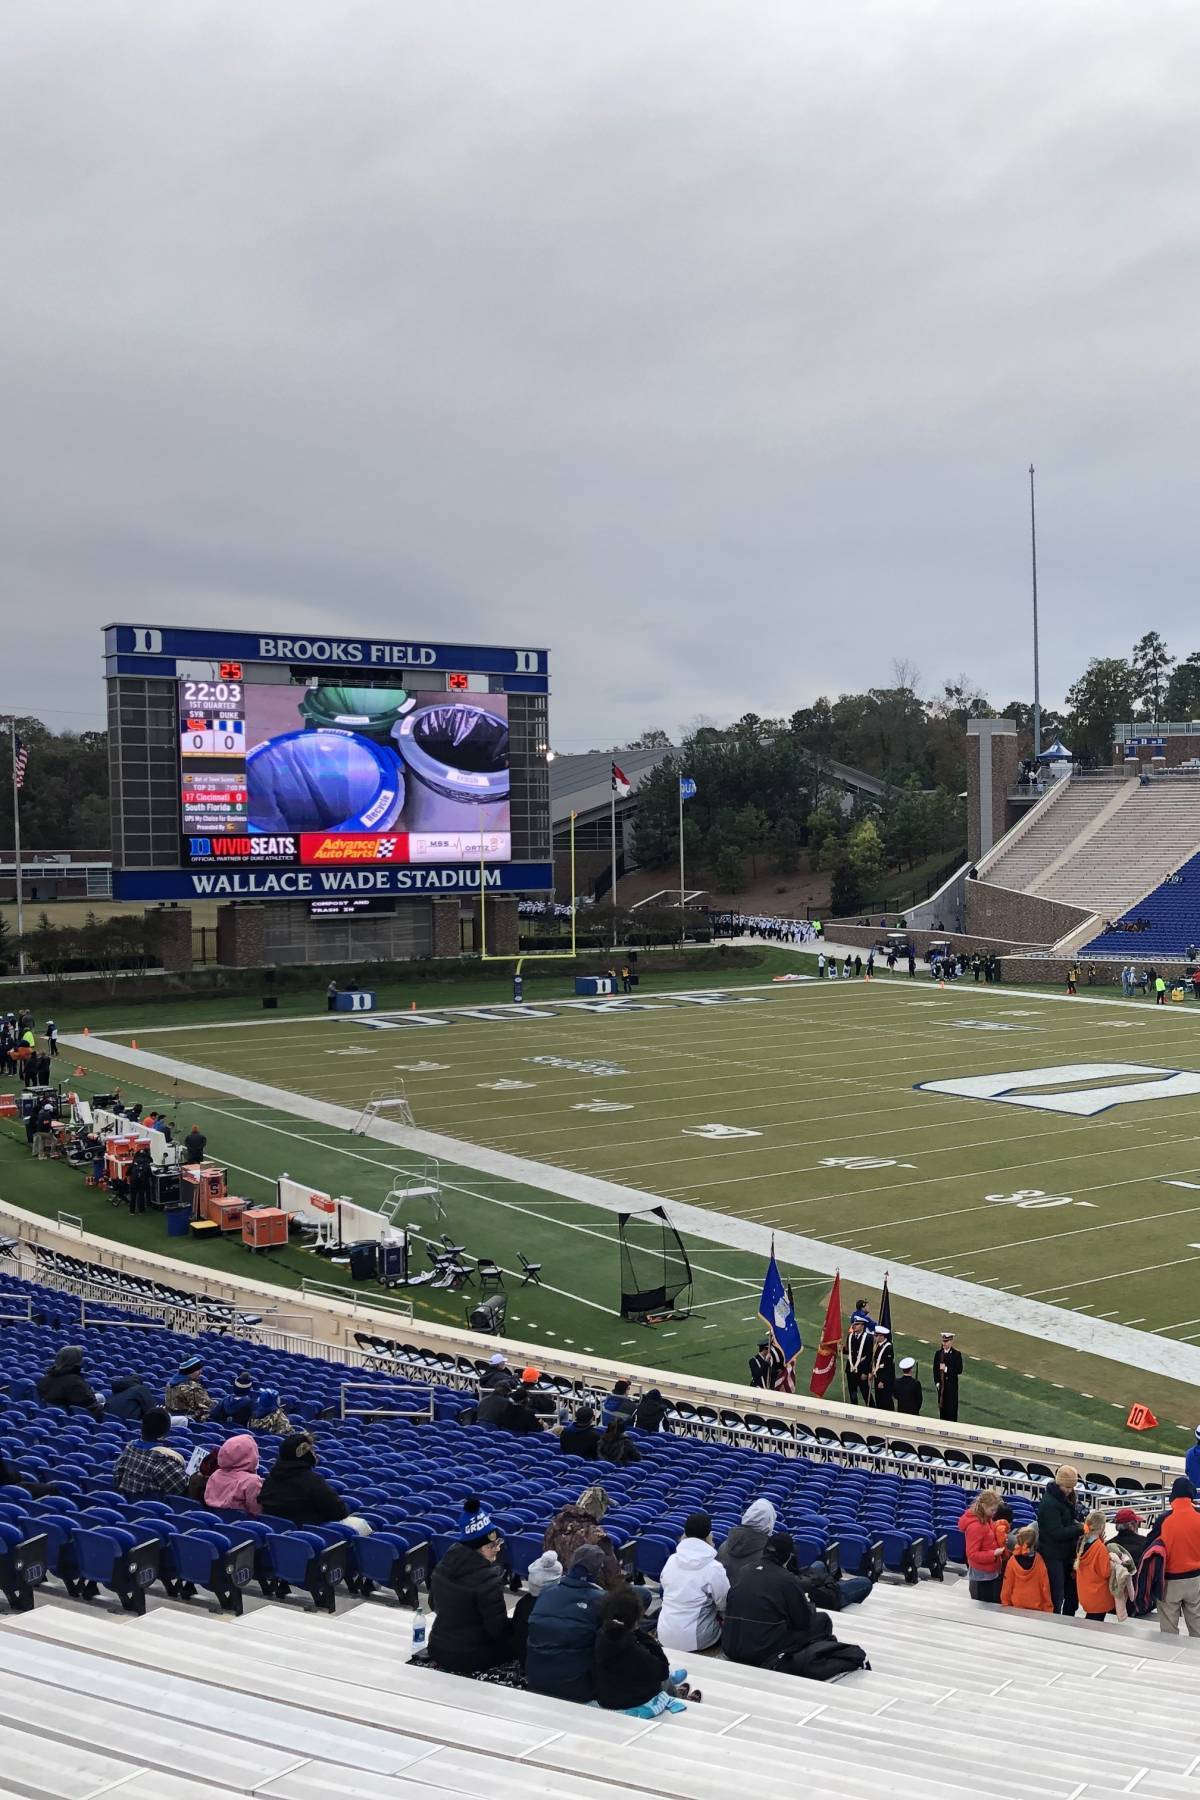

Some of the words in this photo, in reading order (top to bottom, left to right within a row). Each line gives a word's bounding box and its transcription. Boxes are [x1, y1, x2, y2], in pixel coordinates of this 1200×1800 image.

[132, 628, 163, 653] D
[258, 638, 363, 662] BROOKS
[370, 644, 437, 664] FIELD
[514, 650, 539, 673] D
[220, 663, 241, 679] 25
[449, 674, 468, 689] 25
[184, 682, 241, 702] 22:03
[189, 701, 202, 709] 1ST
[203, 702, 237, 710] QUARTER
[189, 710, 204, 718] SYR
[219, 711, 239, 719] DUKE
[192, 734, 204, 750] 0
[224, 735, 235, 750] 0
[196, 793, 230, 802] Cincinnati
[235, 793, 242, 802] 0
[184, 803, 206, 812] South
[207, 803, 231, 812] Florida
[235, 803, 243, 812] 0
[364, 795, 390, 822] Recycle
[321, 838, 376, 850] Advance
[313, 849, 344, 859] Auto
[343, 849, 373, 859] Parts
[191, 873, 313, 894] WALLACE
[320, 871, 391, 890] WADE
[396, 869, 502, 888] STADIUM
[332, 993, 770, 1030] DUKE
[816, 1155, 898, 1171] 40
[984, 1189, 1074, 1209] 30
[1129, 1407, 1144, 1426] 10
